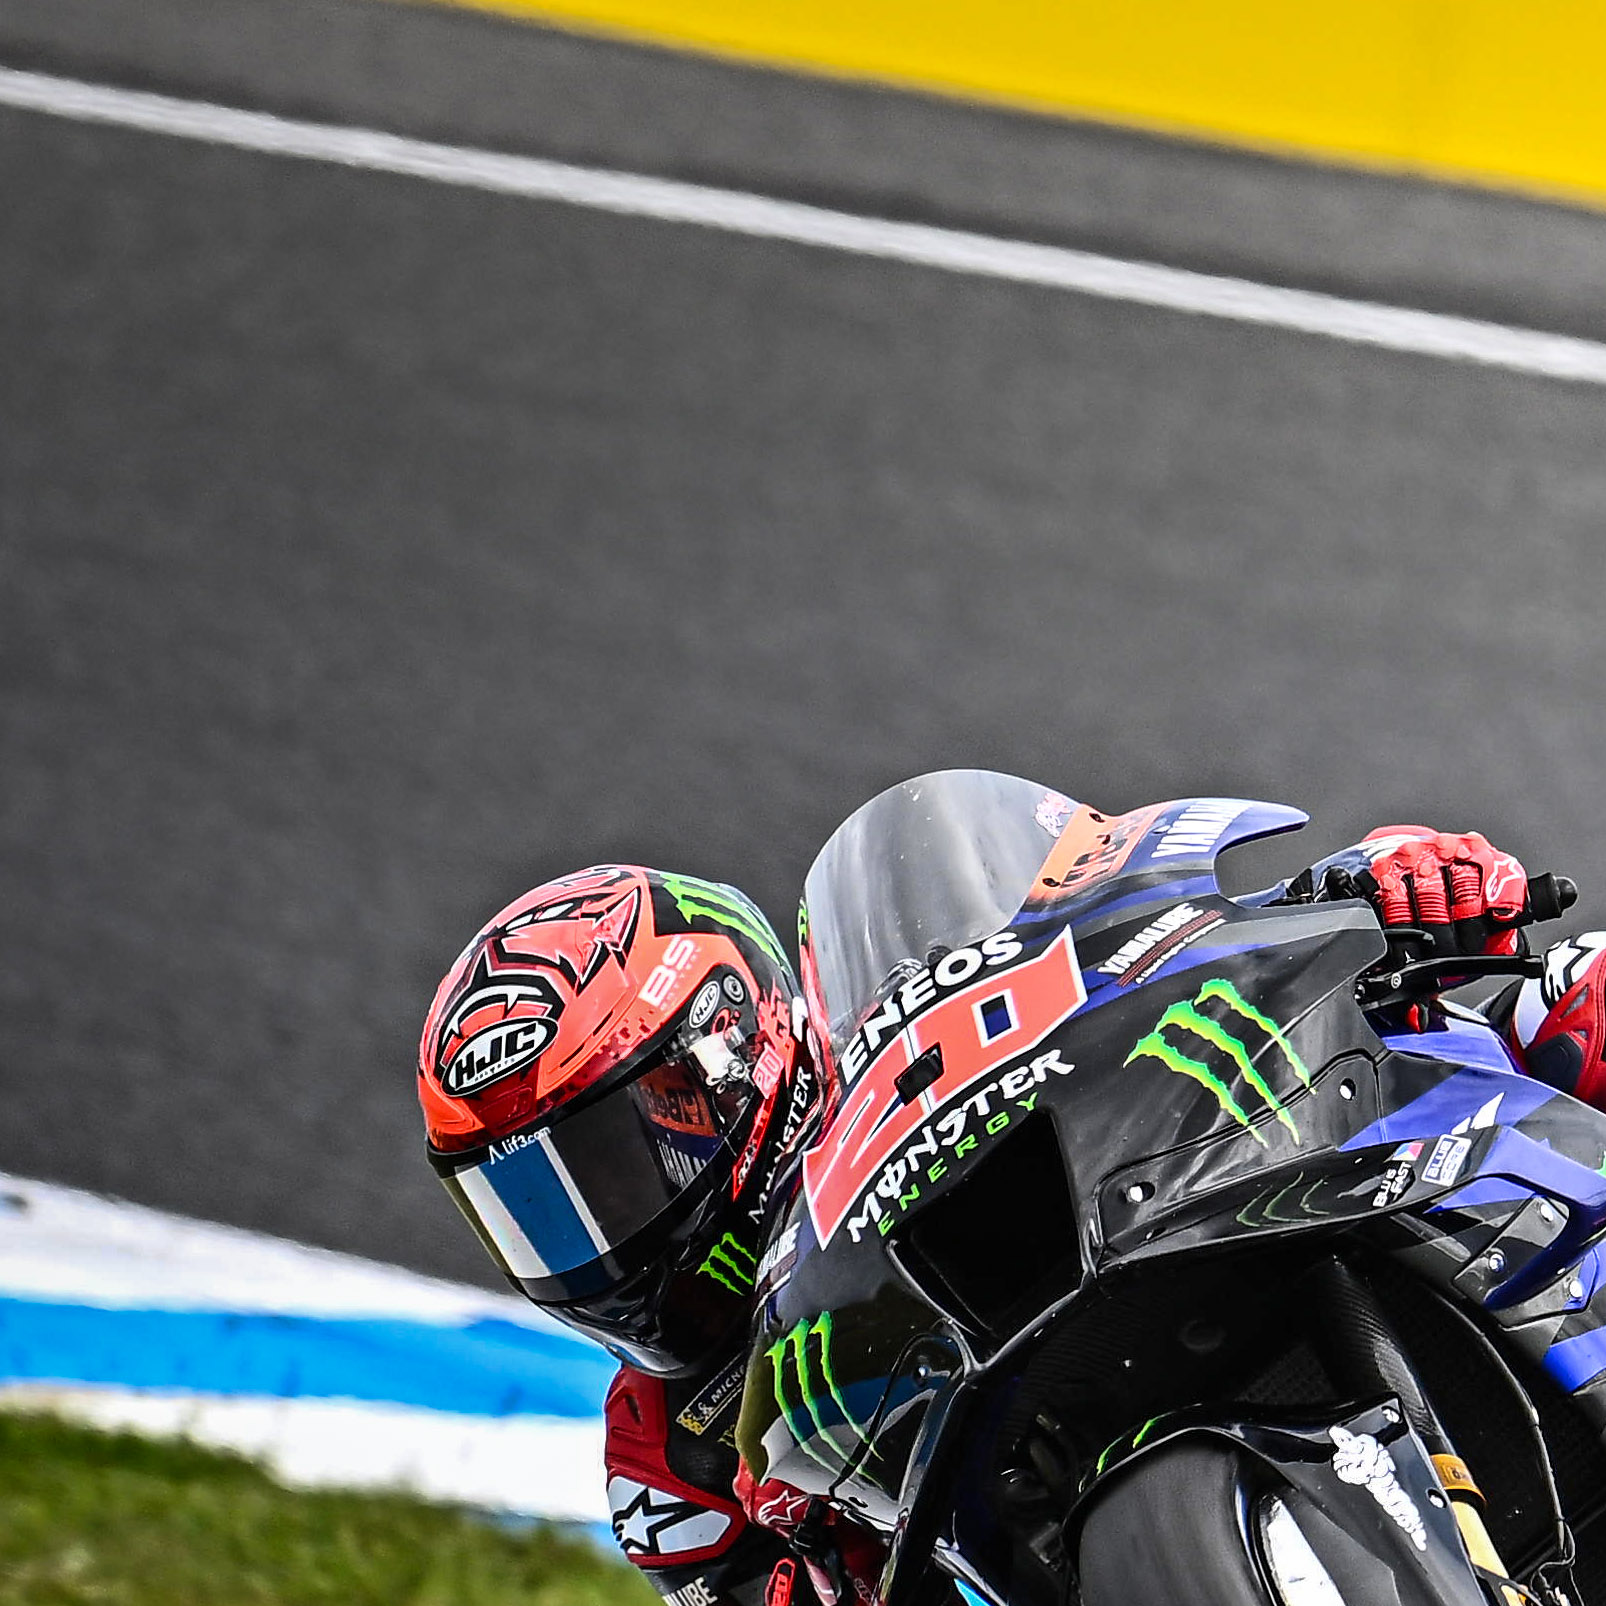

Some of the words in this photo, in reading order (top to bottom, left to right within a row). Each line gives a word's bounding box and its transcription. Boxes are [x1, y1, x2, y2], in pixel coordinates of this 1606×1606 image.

[637, 933, 695, 1009] BS
[694, 985, 716, 1023] HJC
[839, 931, 1024, 1086] ENEOS
[454, 1020, 539, 1091] HJC
[803, 923, 1089, 1251] 20
[501, 1126, 552, 1156] lif3.com
[877, 1091, 1039, 1238] ENERGY
